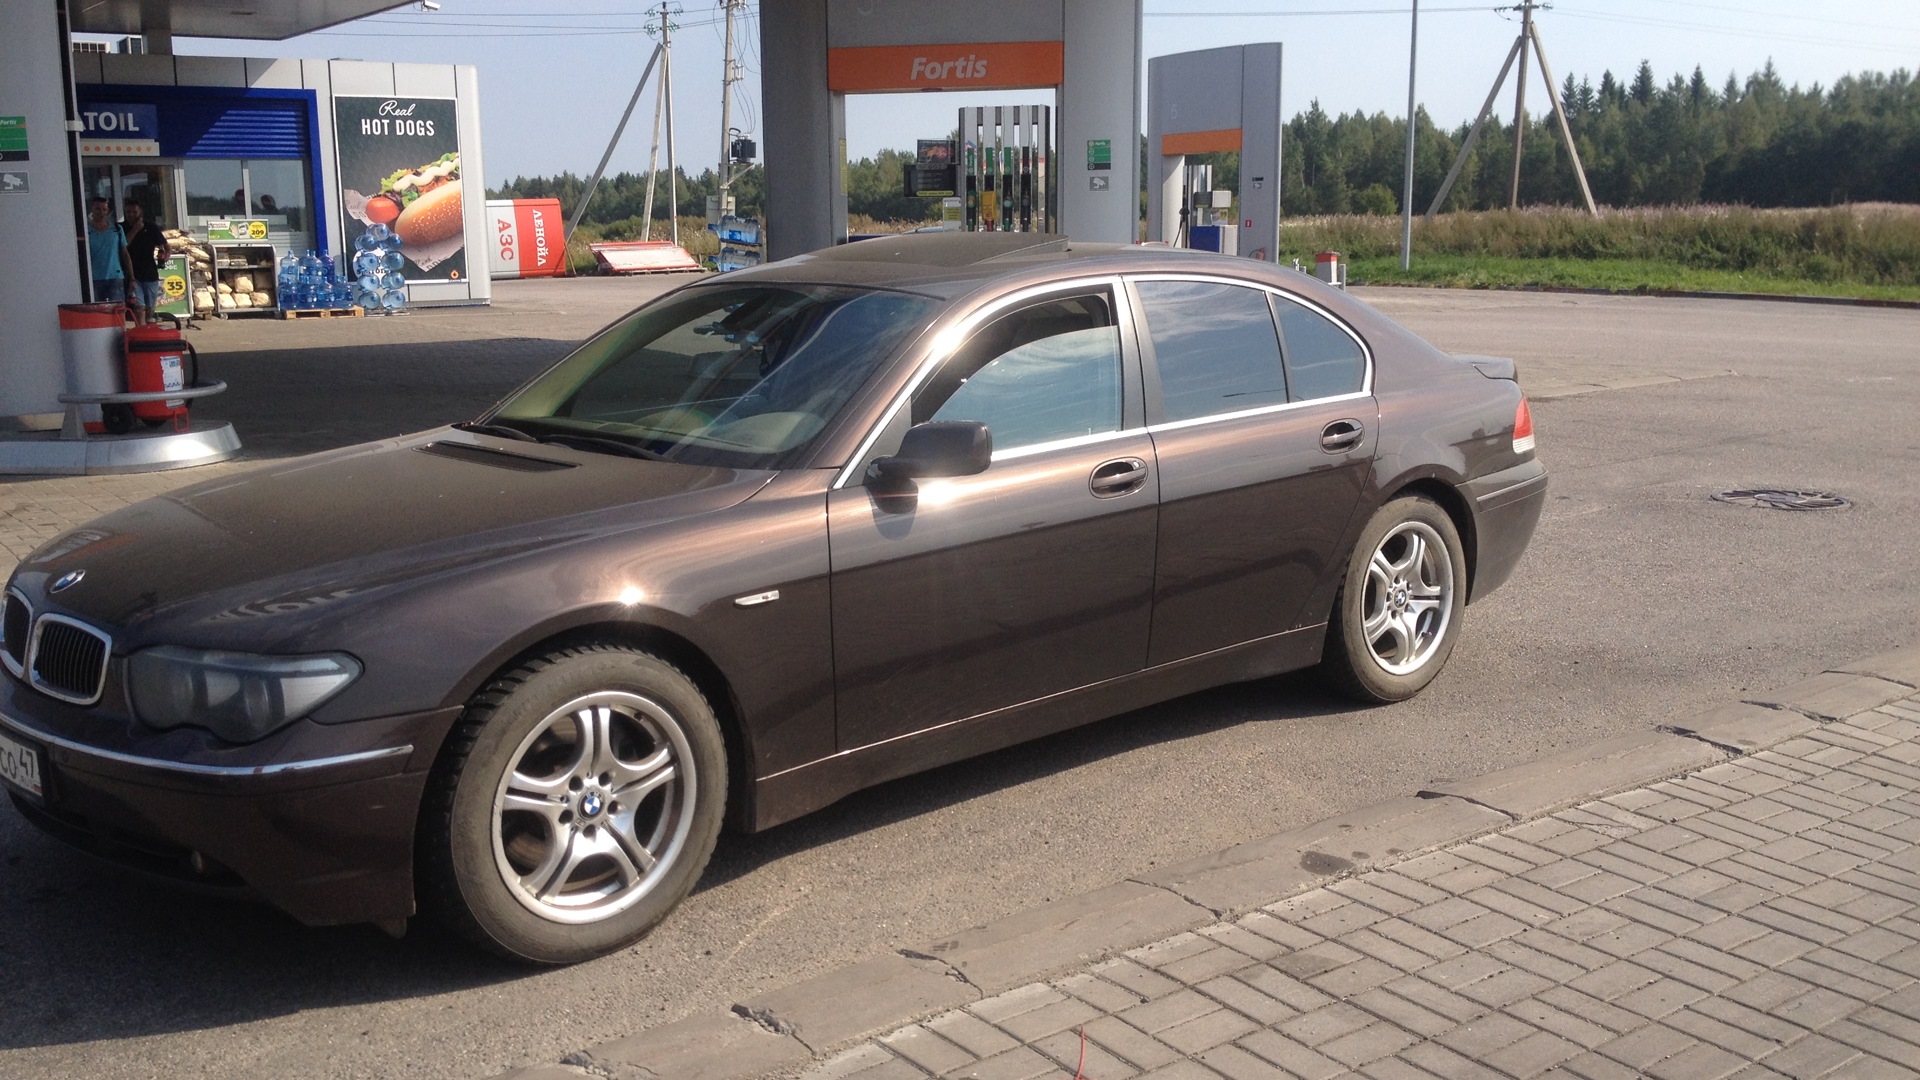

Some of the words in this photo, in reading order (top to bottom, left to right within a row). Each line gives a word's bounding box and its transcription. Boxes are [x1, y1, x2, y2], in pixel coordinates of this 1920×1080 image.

[910, 54, 988, 80] Fortis
[379, 100, 416, 117] Real
[361, 119, 390, 135] HOT
[396, 120, 435, 137] DOGS
[497, 218, 514, 261] АЗС
[532, 209, 549, 267] ЛЕНОЙЛ
[167, 281, 184, 291] 35
[20, 748, 34, 779] 47
